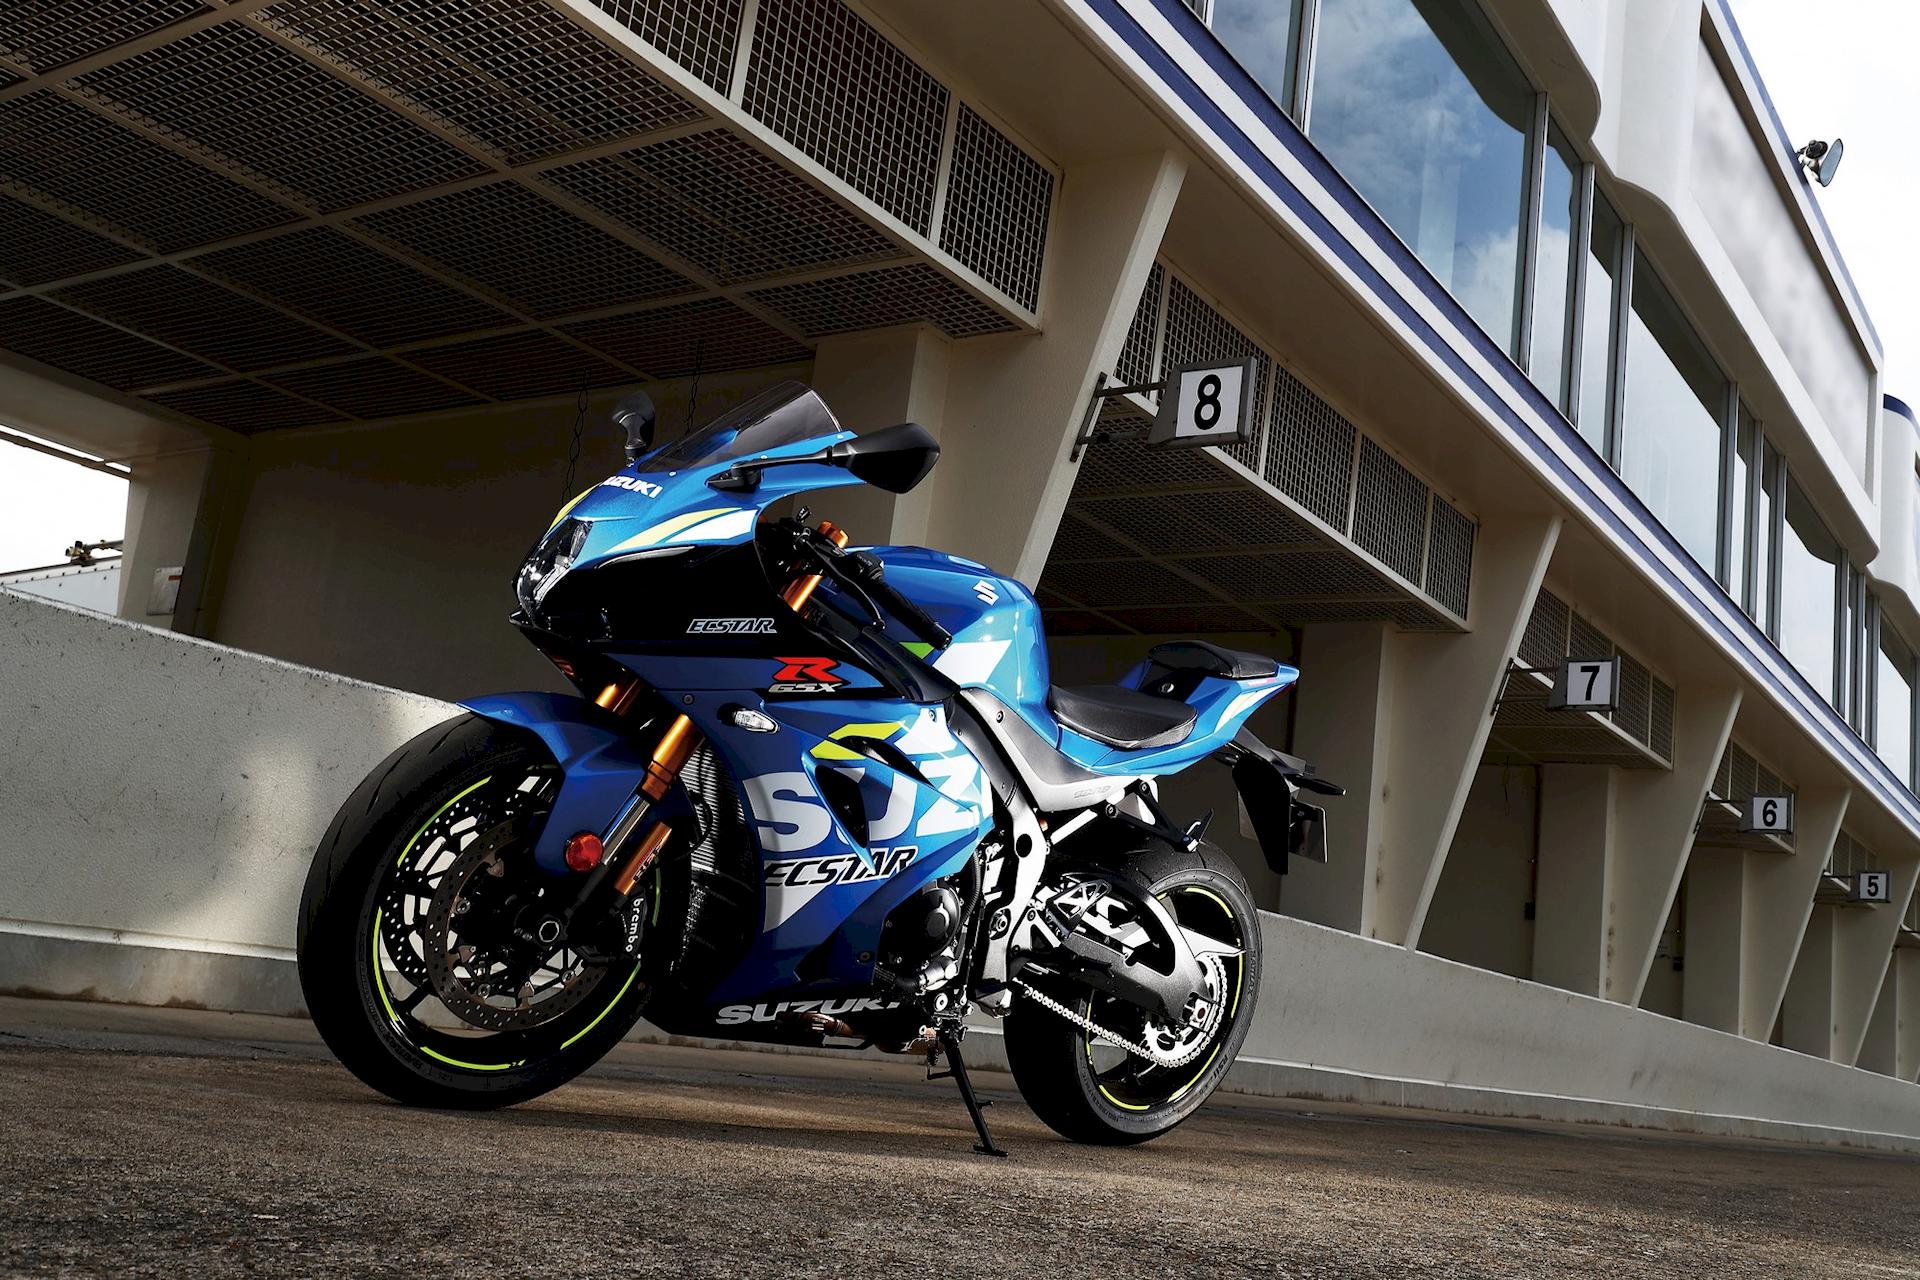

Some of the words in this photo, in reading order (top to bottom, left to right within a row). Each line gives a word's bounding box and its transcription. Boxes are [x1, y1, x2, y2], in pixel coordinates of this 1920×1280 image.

[1194, 374, 1221, 430] 8
[600, 476, 663, 499] UZUKI
[686, 618, 777, 634] ECSTAR
[773, 657, 844, 682] R
[768, 683, 842, 693] GSX
[1580, 666, 1600, 701] 7
[1762, 800, 1778, 827] 6
[765, 845, 919, 887] ECSTAR
[1867, 876, 1879, 897] 5
[625, 898, 645, 953] brembo
